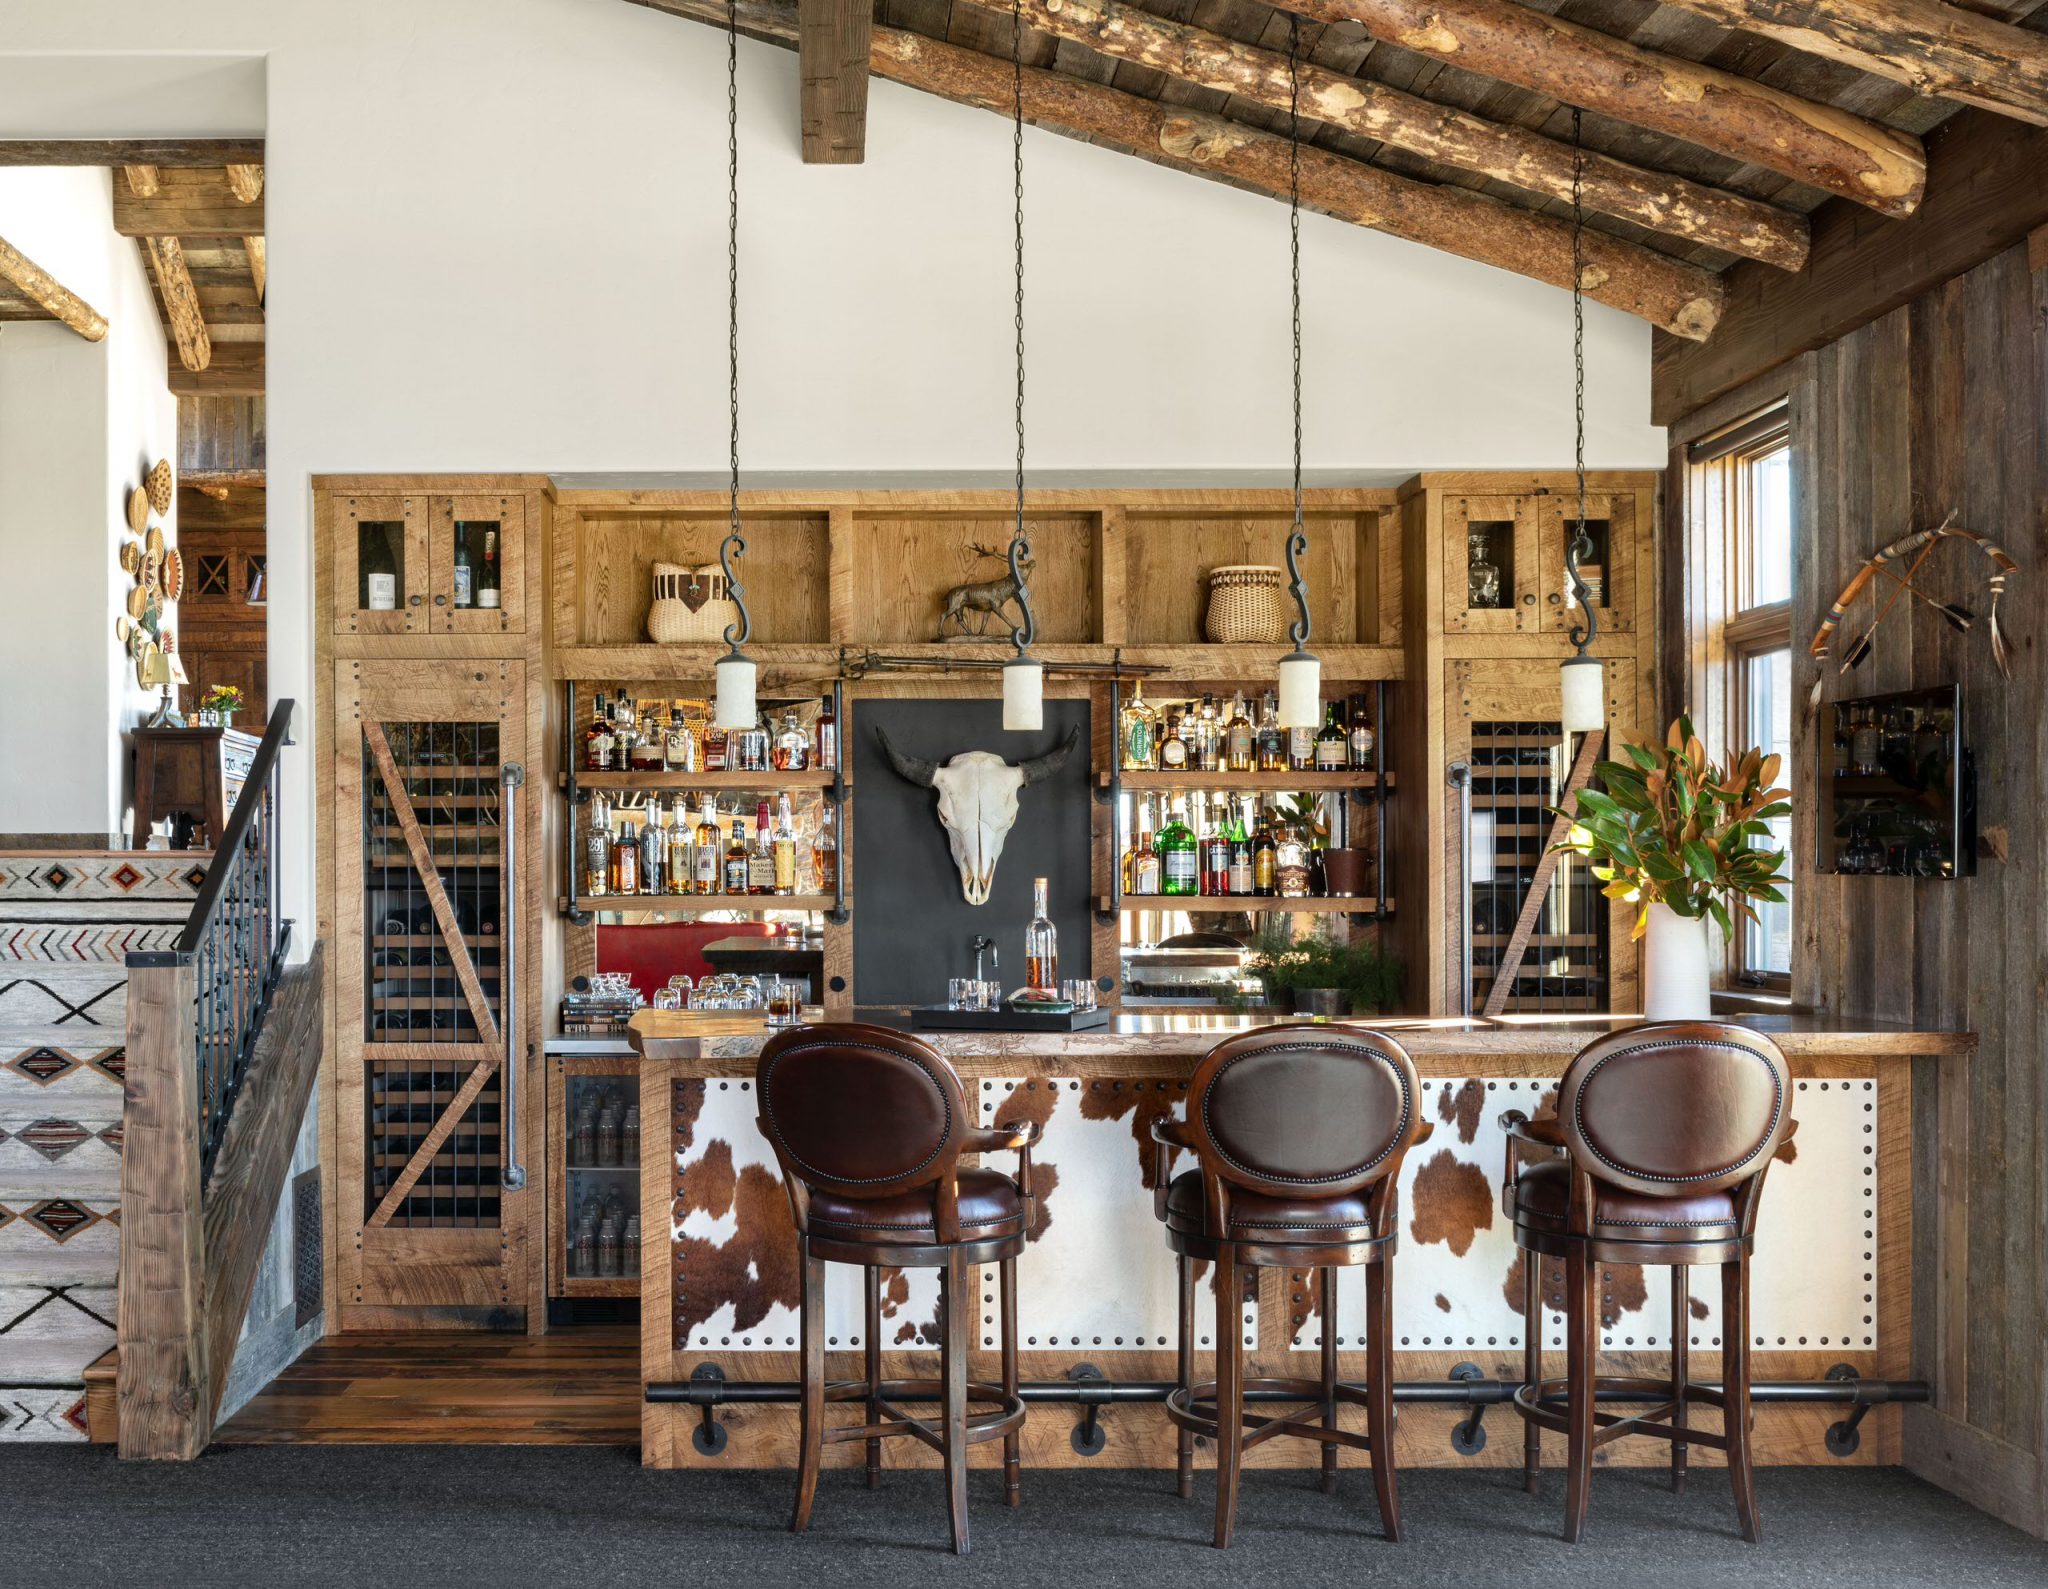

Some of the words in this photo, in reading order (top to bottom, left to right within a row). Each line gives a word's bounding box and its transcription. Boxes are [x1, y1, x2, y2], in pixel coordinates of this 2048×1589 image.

[588, 837, 605, 852] 291
[570, 1024, 590, 1032] WILD
[607, 1024, 626, 1032] BILL
